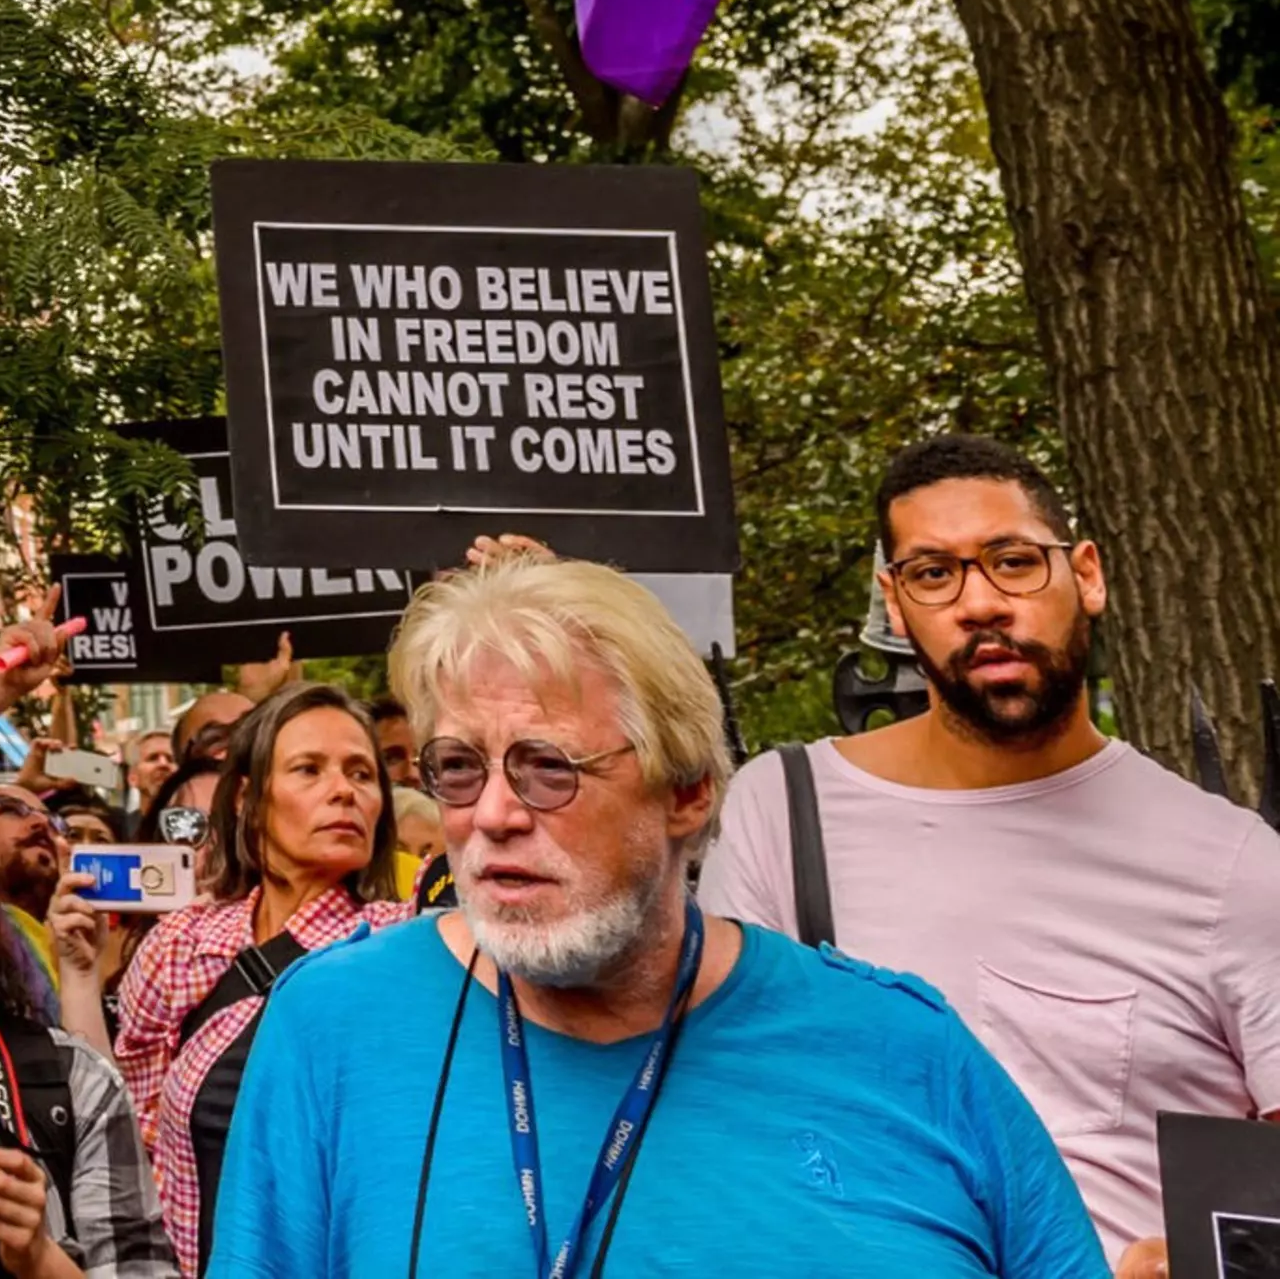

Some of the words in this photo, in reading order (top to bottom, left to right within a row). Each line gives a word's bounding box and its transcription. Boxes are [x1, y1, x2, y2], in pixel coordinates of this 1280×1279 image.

[266, 262, 338, 308] WE
[350, 264, 462, 311] WHO
[476, 267, 673, 315] BELIEVE
[332, 317, 381, 362] IN
[395, 318, 620, 367] FREEDOM
[313, 369, 509, 417] CANNOT
[526, 374, 643, 420] REST
[292, 424, 437, 471] UNTIL
[451, 427, 495, 472] IT
[510, 428, 676, 476] COMES
[512, 1080, 530, 1133] DOHMH
[603, 1119, 634, 1171] DOHMH
